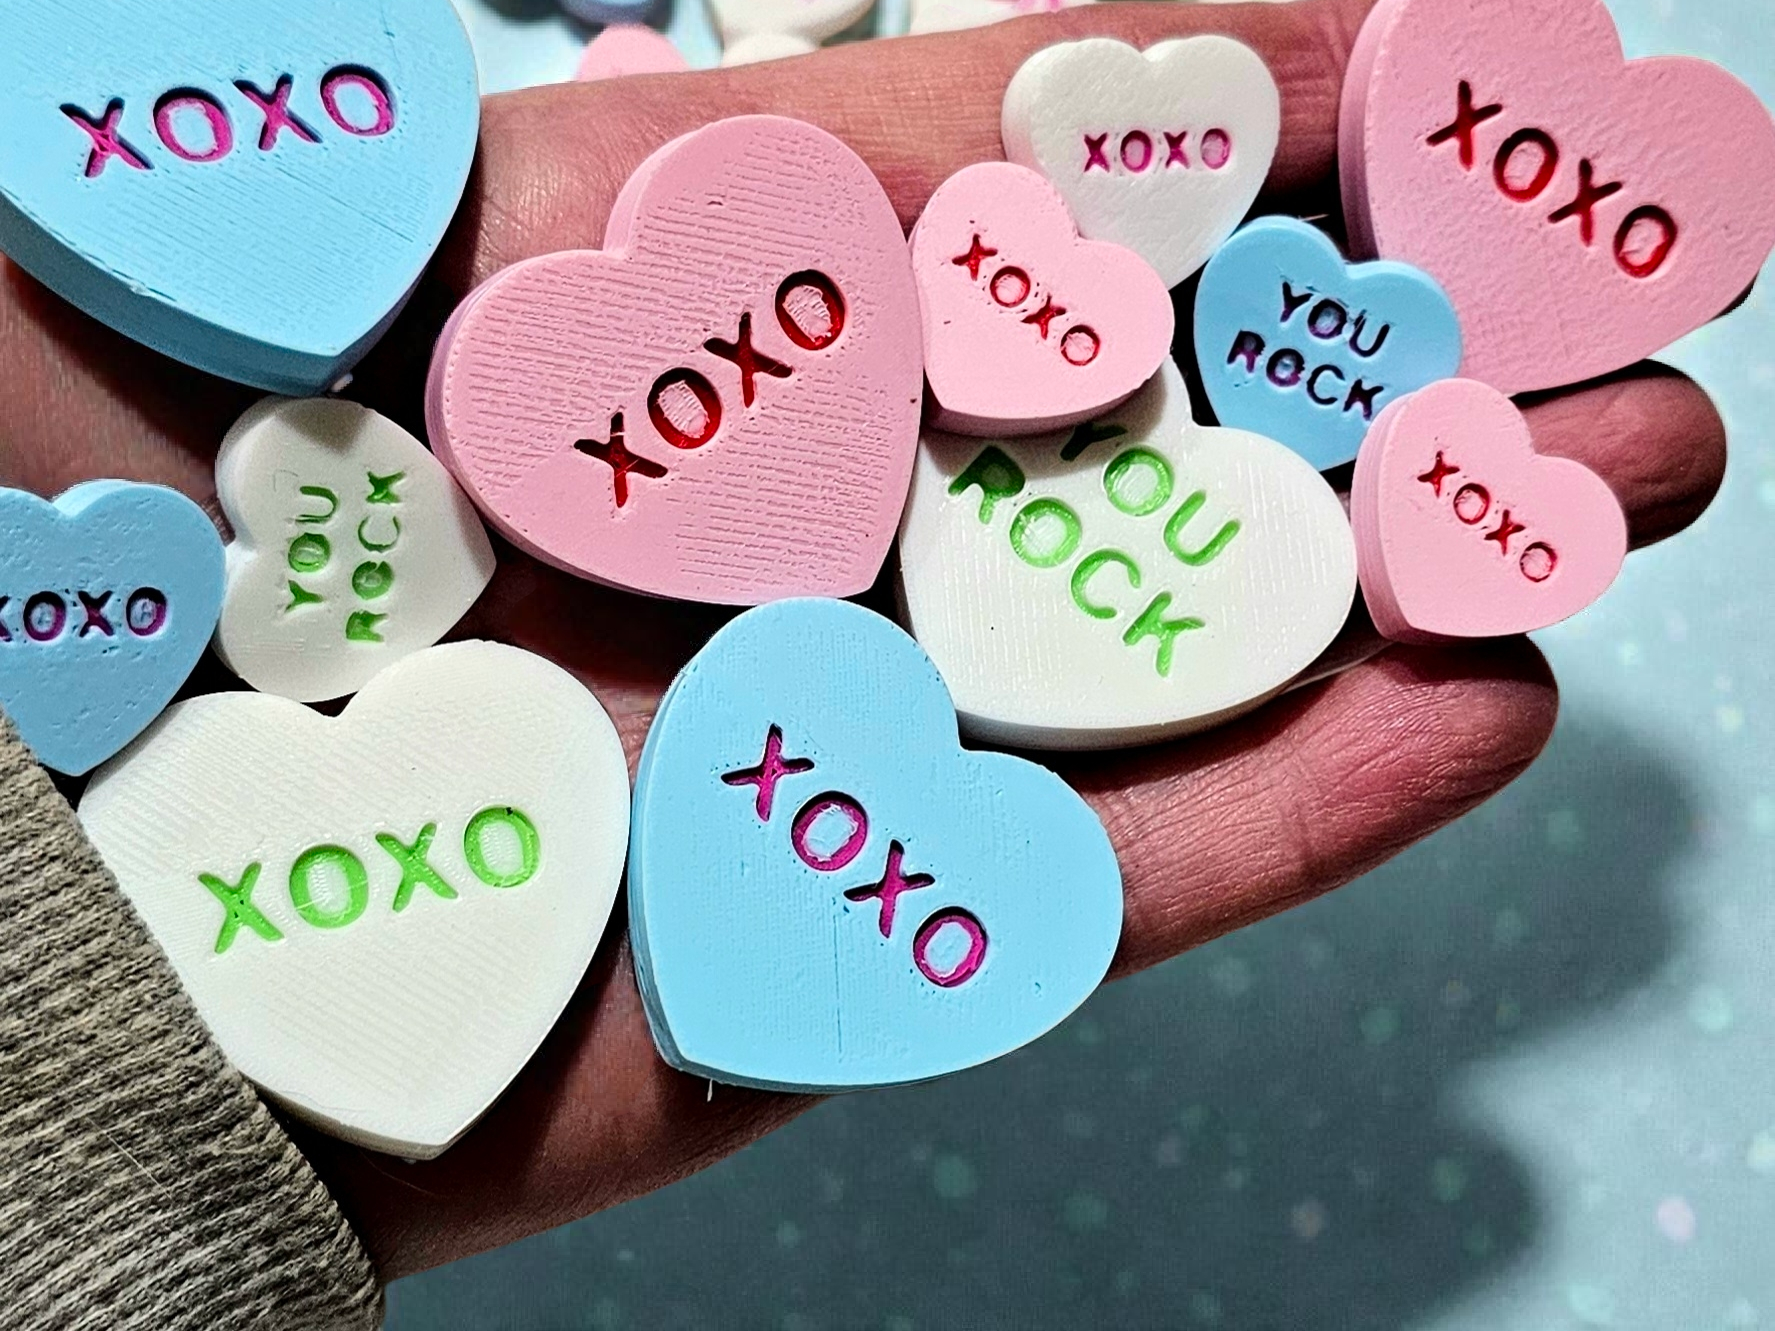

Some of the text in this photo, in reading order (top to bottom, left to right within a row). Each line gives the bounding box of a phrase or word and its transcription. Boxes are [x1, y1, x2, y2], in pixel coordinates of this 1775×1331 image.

[60, 63, 398, 178] XOXO
[1083, 128, 1232, 173] XOXO
[1426, 80, 1678, 279] XOXO
[952, 233, 1101, 367] XOXO
[1280, 281, 1391, 358] YOU
[574, 269, 847, 507] XOXO
[1227, 330, 1384, 421] ROCK
[284, 484, 340, 613] YOU
[345, 471, 406, 643] ROCK
[948, 445, 1206, 678] ROCK
[1060, 422, 1241, 567] YOU
[1417, 450, 1559, 584] XOXO
[198, 804, 542, 954] XOXO
[721, 722, 990, 989] XOXO
